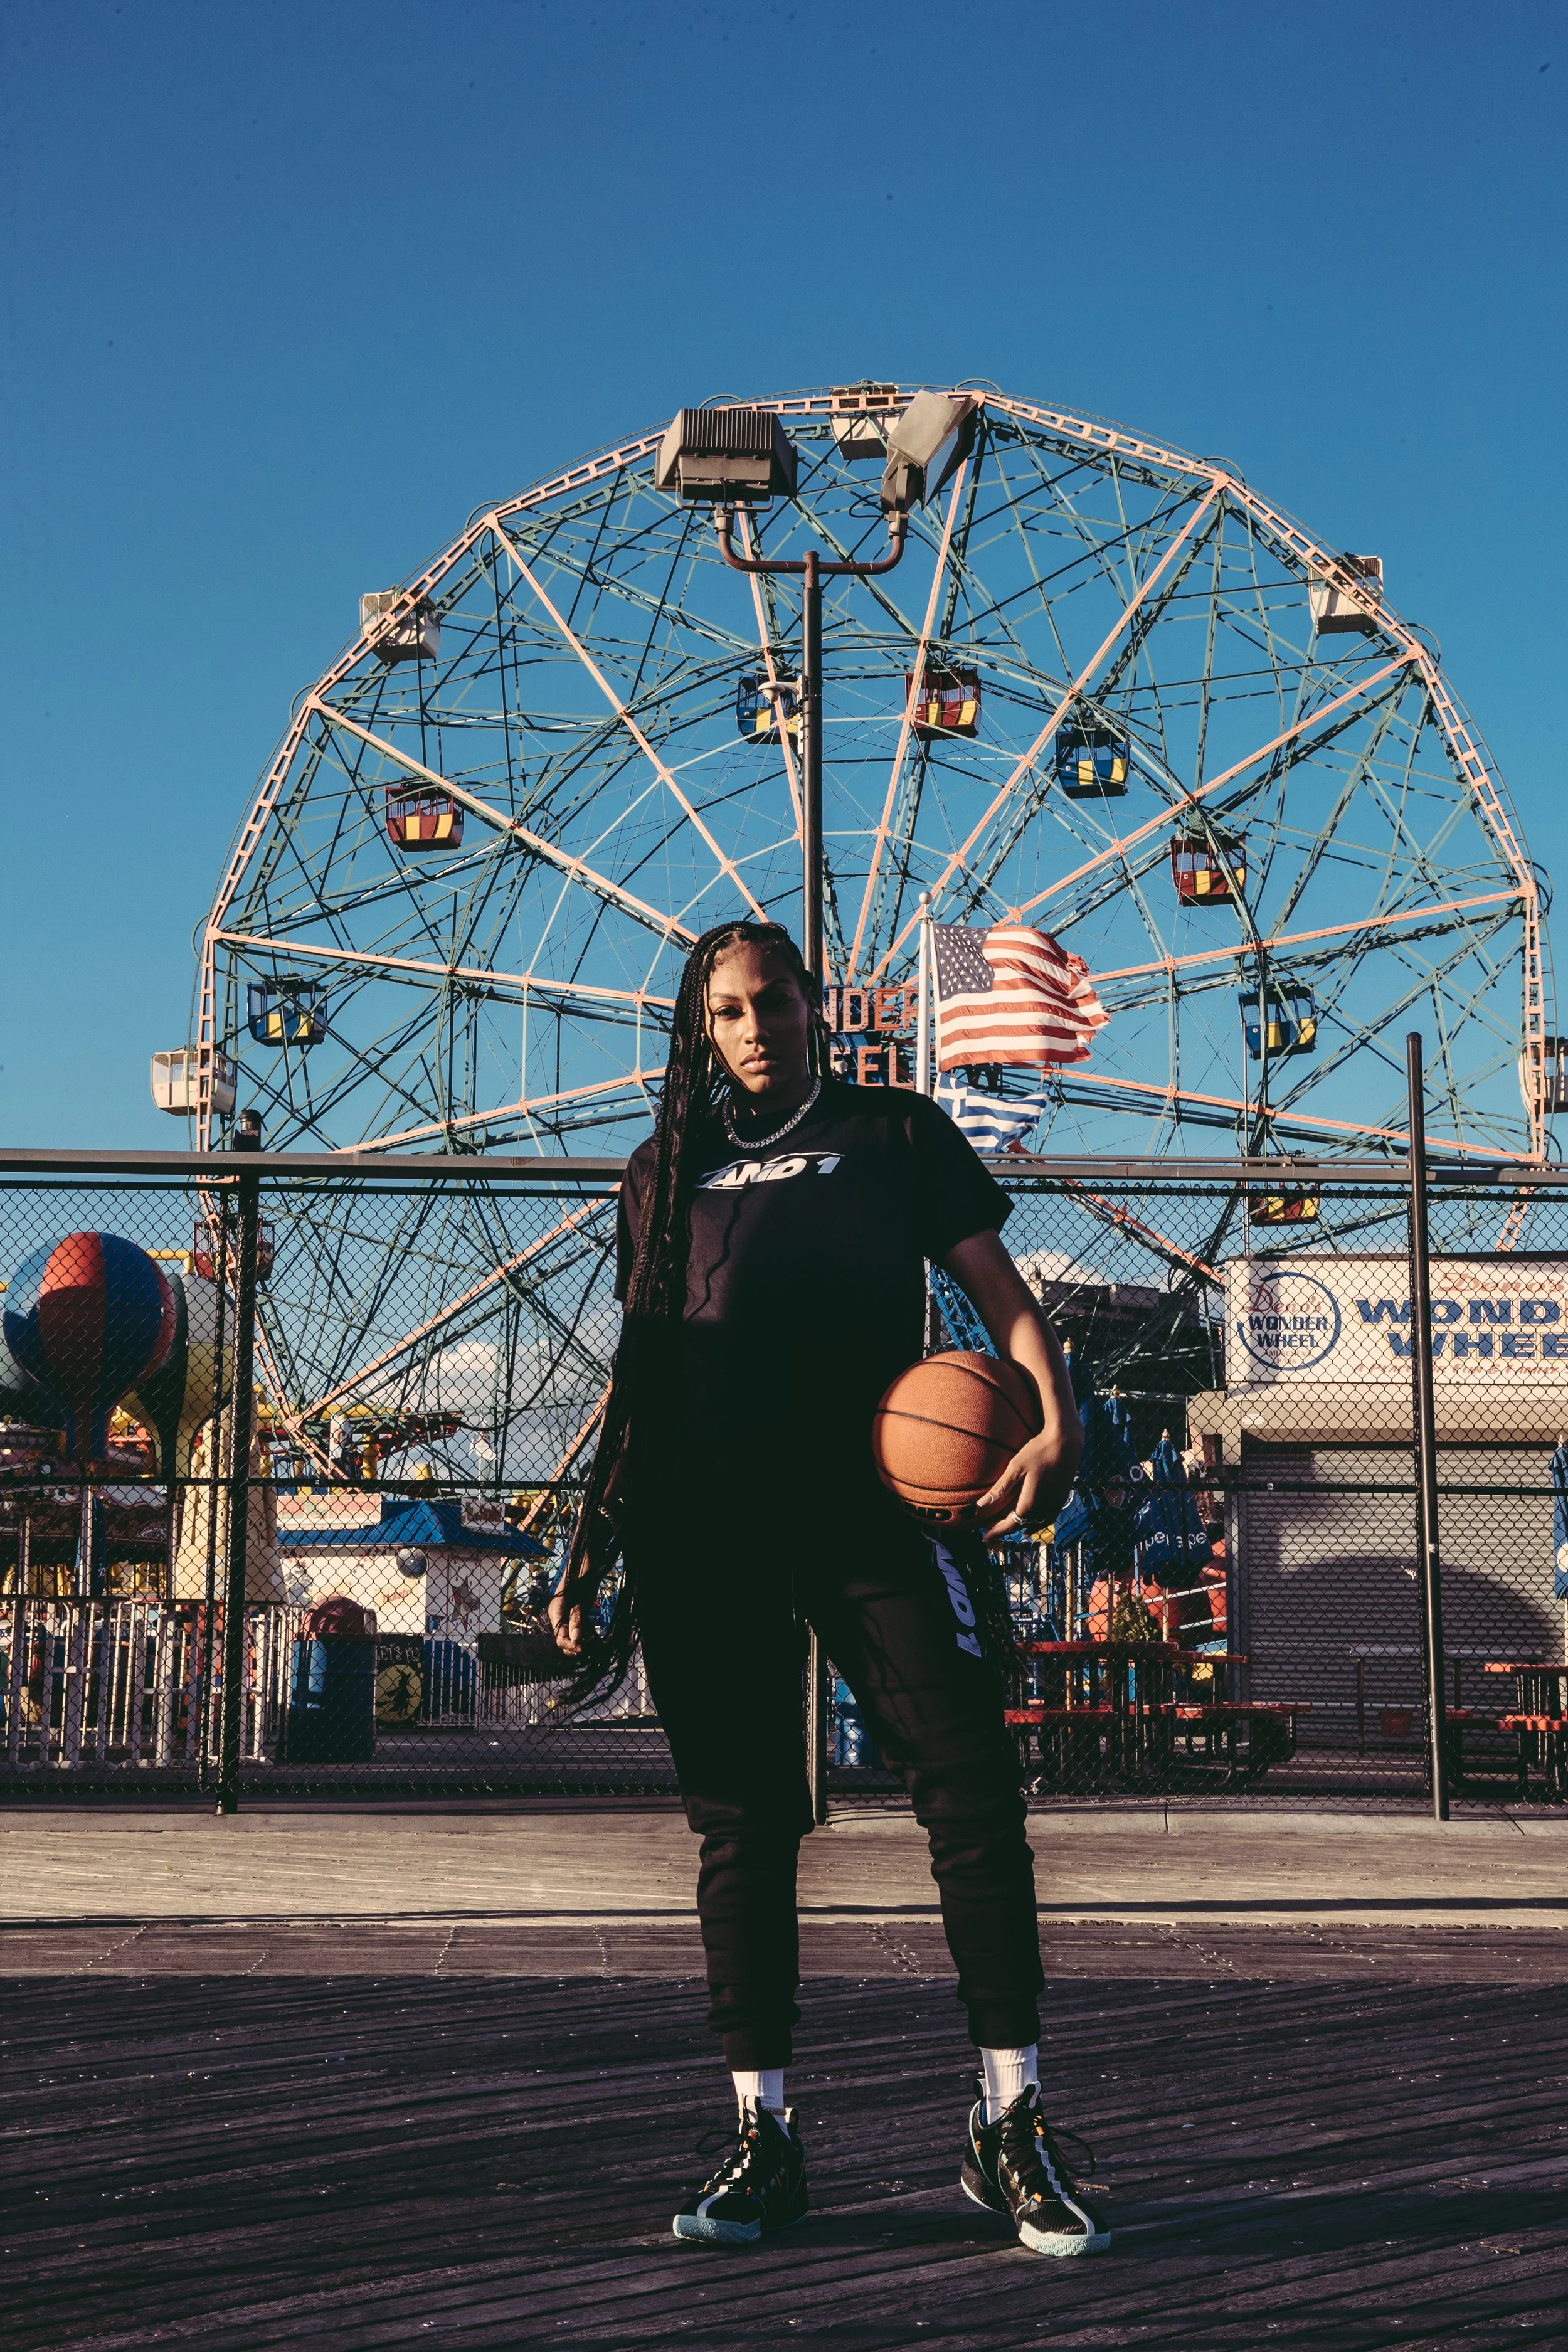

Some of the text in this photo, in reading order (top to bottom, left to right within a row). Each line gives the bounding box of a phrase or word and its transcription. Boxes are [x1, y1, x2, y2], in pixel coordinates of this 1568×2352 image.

[823, 987, 919, 1032] NDER
[830, 1046, 915, 1090] EEL
[704, 1157, 841, 1189] AND 1
[1437, 1272, 1564, 1293] Deno's
[1240, 1283, 1322, 1313] Deno's
[1353, 1298, 1563, 1325] WOND
[1248, 1316, 1328, 1331] WONDER
[1256, 1333, 1320, 1348] WHEEL
[1432, 1365, 1446, 1374] OR
[1452, 1364, 1484, 1374] FUN
[1505, 1364, 1560, 1374] FAMILY
